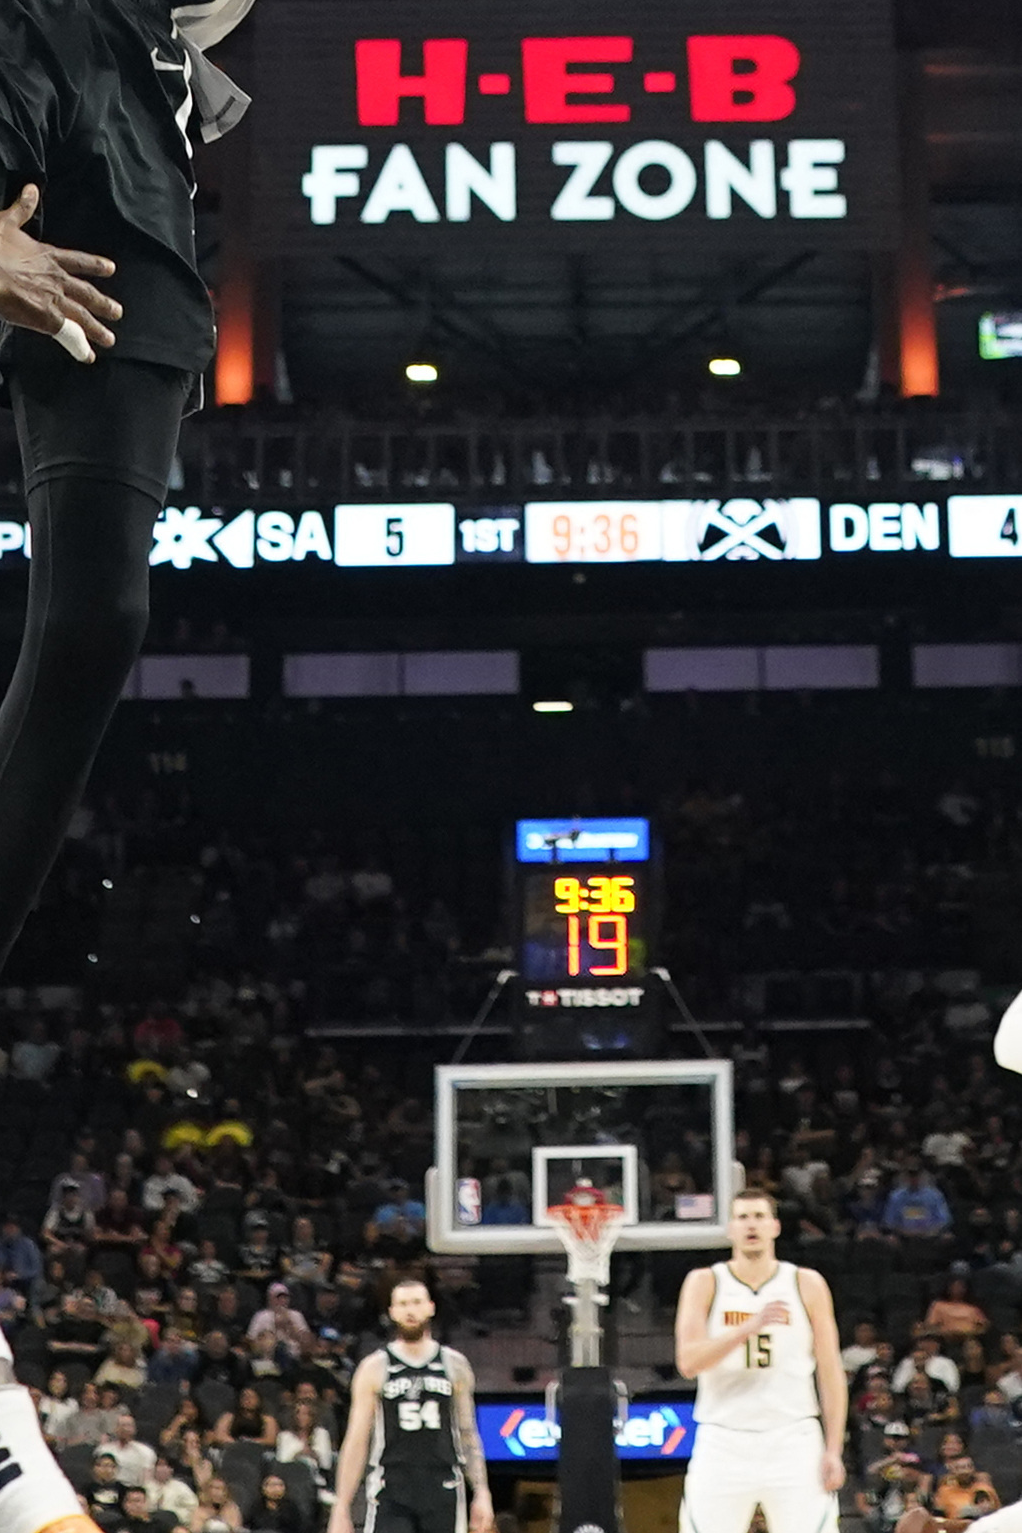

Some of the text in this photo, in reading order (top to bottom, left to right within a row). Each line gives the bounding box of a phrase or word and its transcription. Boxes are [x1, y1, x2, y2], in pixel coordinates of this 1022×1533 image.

[302, 139, 847, 225] FAN ZONE
[256, 510, 333, 561] SA
[385, 517, 405, 557] 5
[460, 517, 519, 553] 1ST
[552, 513, 640, 557] 9:36
[830, 502, 940, 552] DEN
[554, 876, 636, 914] 9:36
[567, 914, 628, 976] 19
[744, 1333, 772, 1369] 15
[398, 1399, 442, 1432] 54
